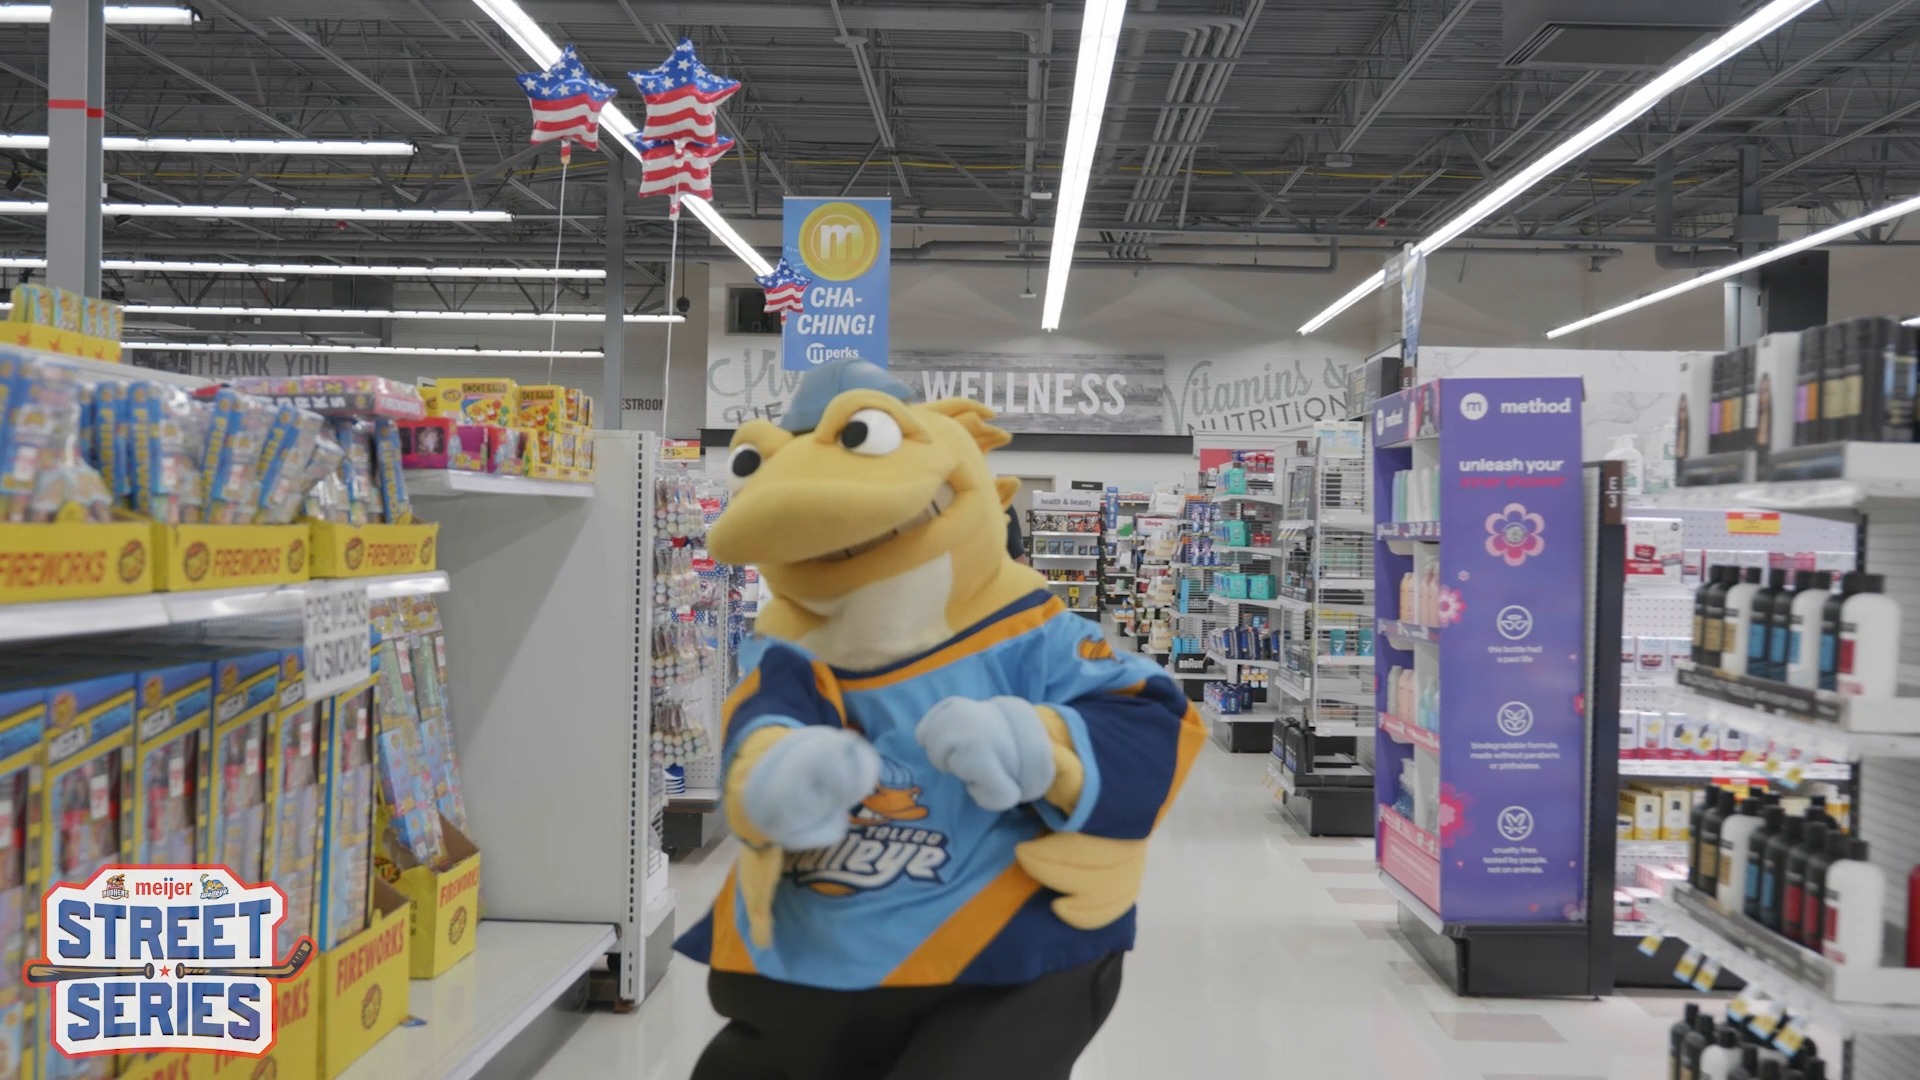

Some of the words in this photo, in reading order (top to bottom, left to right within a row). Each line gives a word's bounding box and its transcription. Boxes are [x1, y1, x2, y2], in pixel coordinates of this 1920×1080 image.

[811, 287, 862, 308] CHA-
[797, 314, 875, 335] CHING!
[194, 352, 270, 376] THANK
[284, 354, 329, 376] YOU
[922, 370, 1126, 415] WELLNESS
[1163, 360, 1312, 435] Vitamins
[622, 398, 662, 411] STROO
[1500, 397, 1571, 414] method
[1459, 458, 1523, 472] unleash
[1525, 459, 1564, 474] your
[1070, 499, 1092, 507] beauty
[213, 548, 281, 578] FIREWORKS
[366, 543, 418, 568] FIREWORKS
[864, 826, 943, 846] TOLEDO
[438, 867, 481, 907] FIREWORKS
[336, 918, 406, 996] FIREWORKS
